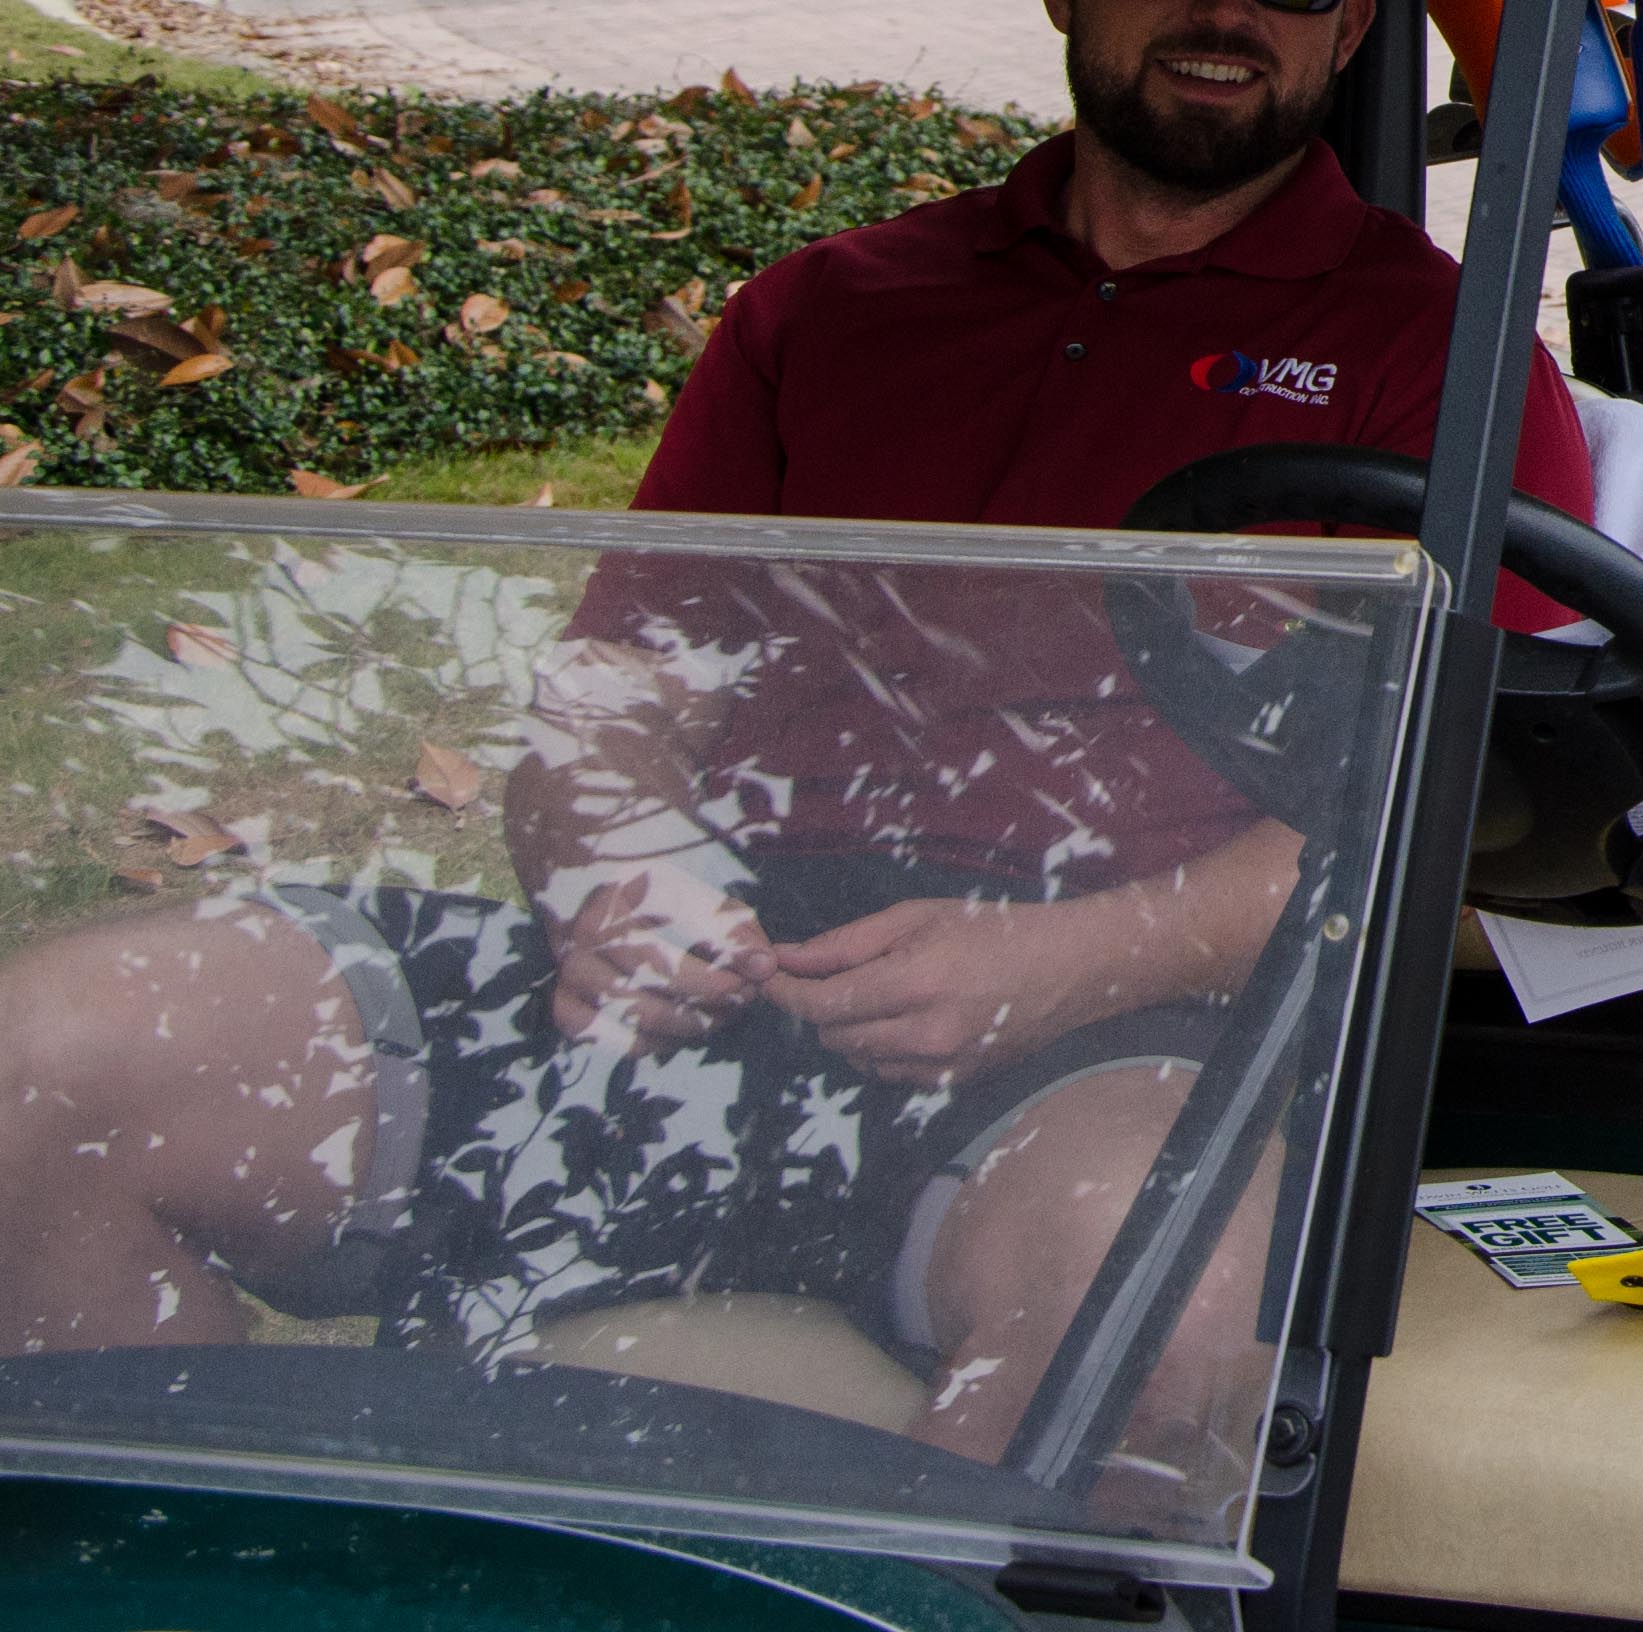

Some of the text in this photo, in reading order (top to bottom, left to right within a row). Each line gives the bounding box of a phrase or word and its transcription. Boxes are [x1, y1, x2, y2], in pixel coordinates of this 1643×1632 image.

[1257, 357, 1338, 392] VMG
[1461, 1213, 1603, 1234] FREE
[1479, 1226, 1606, 1247] GIFT
